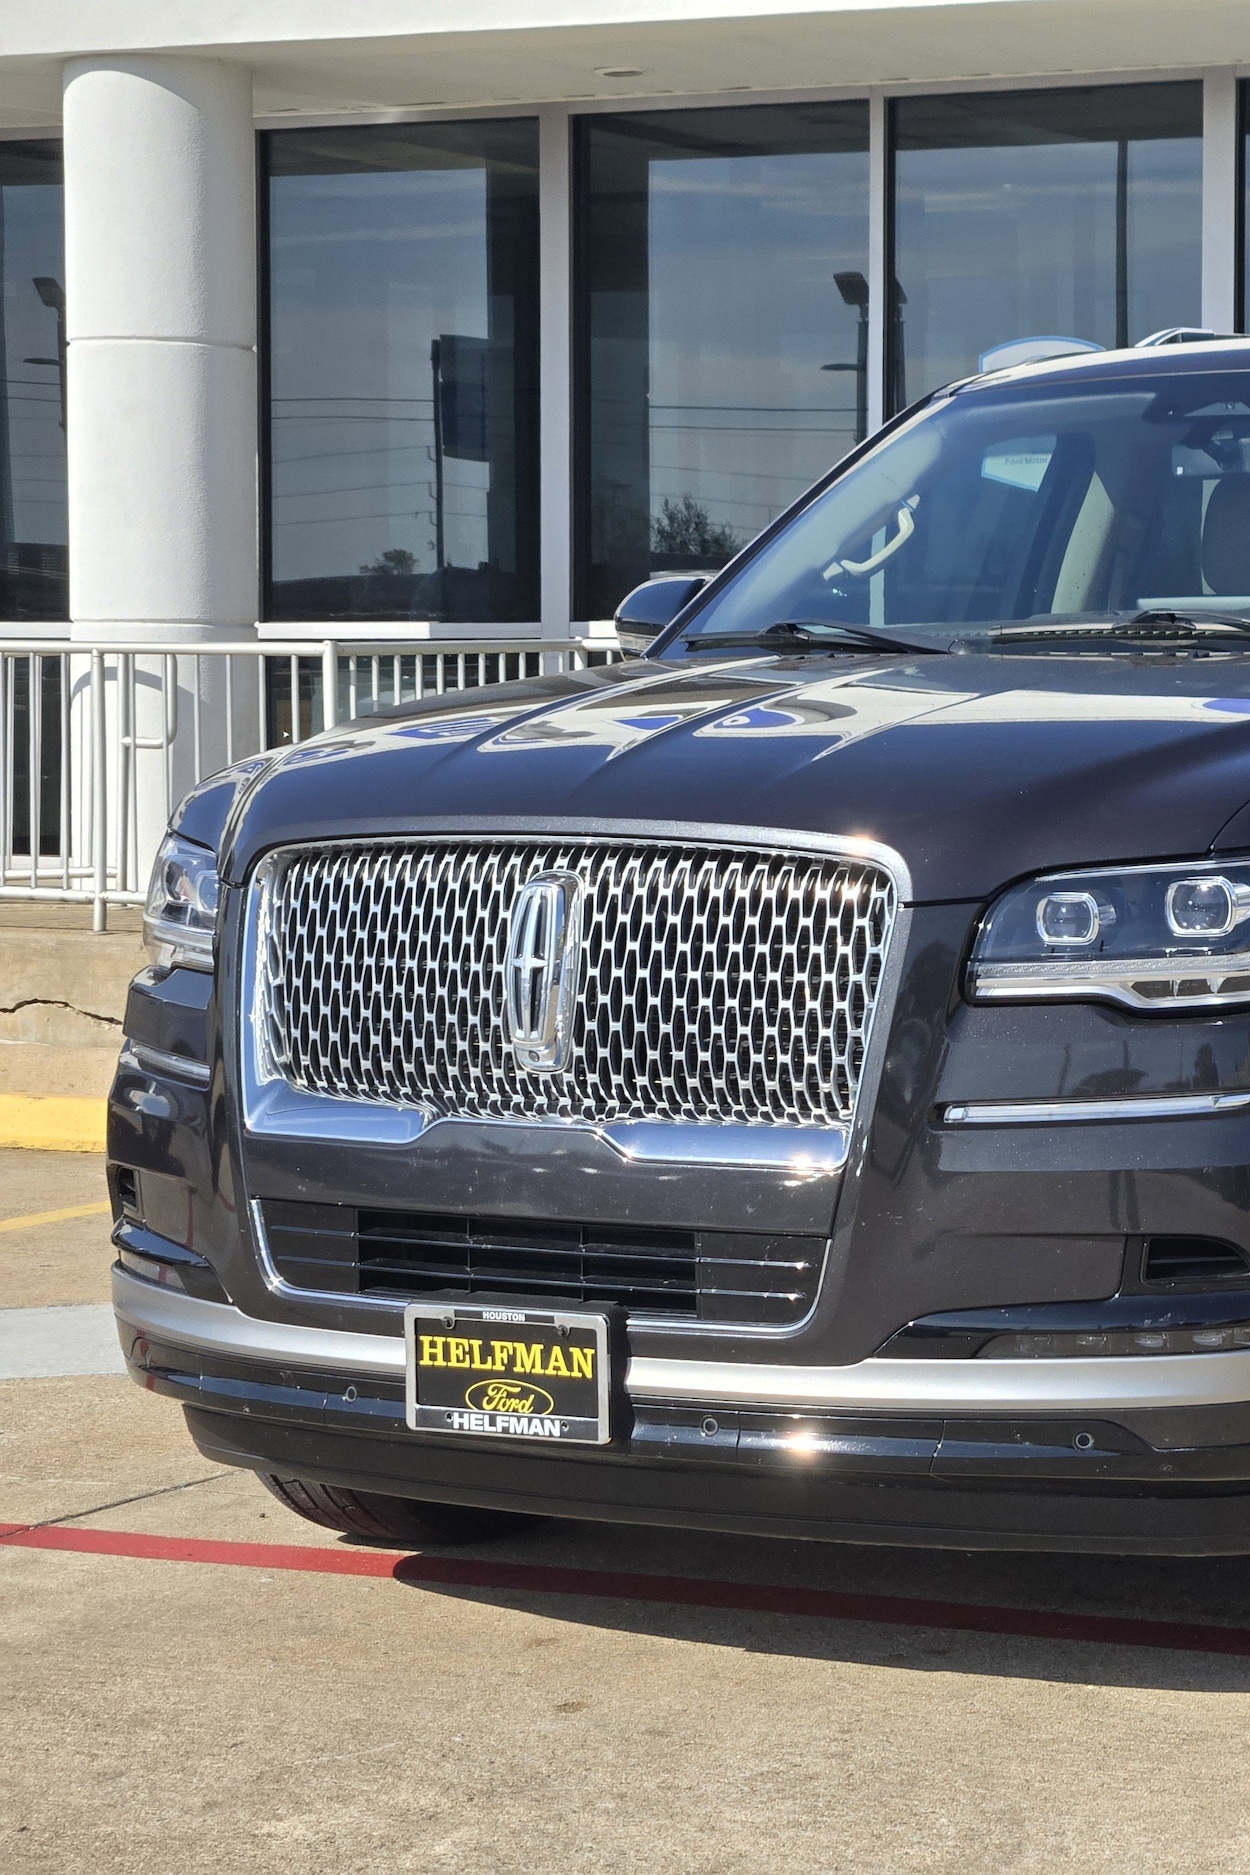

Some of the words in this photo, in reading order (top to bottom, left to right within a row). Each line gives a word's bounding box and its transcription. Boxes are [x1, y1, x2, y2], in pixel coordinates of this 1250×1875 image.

[482, 1311, 526, 1322] HOUSTON
[419, 1335, 595, 1379] HELFMAN
[482, 1383, 535, 1414] Ford
[453, 1412, 561, 1437] HELFMAN
